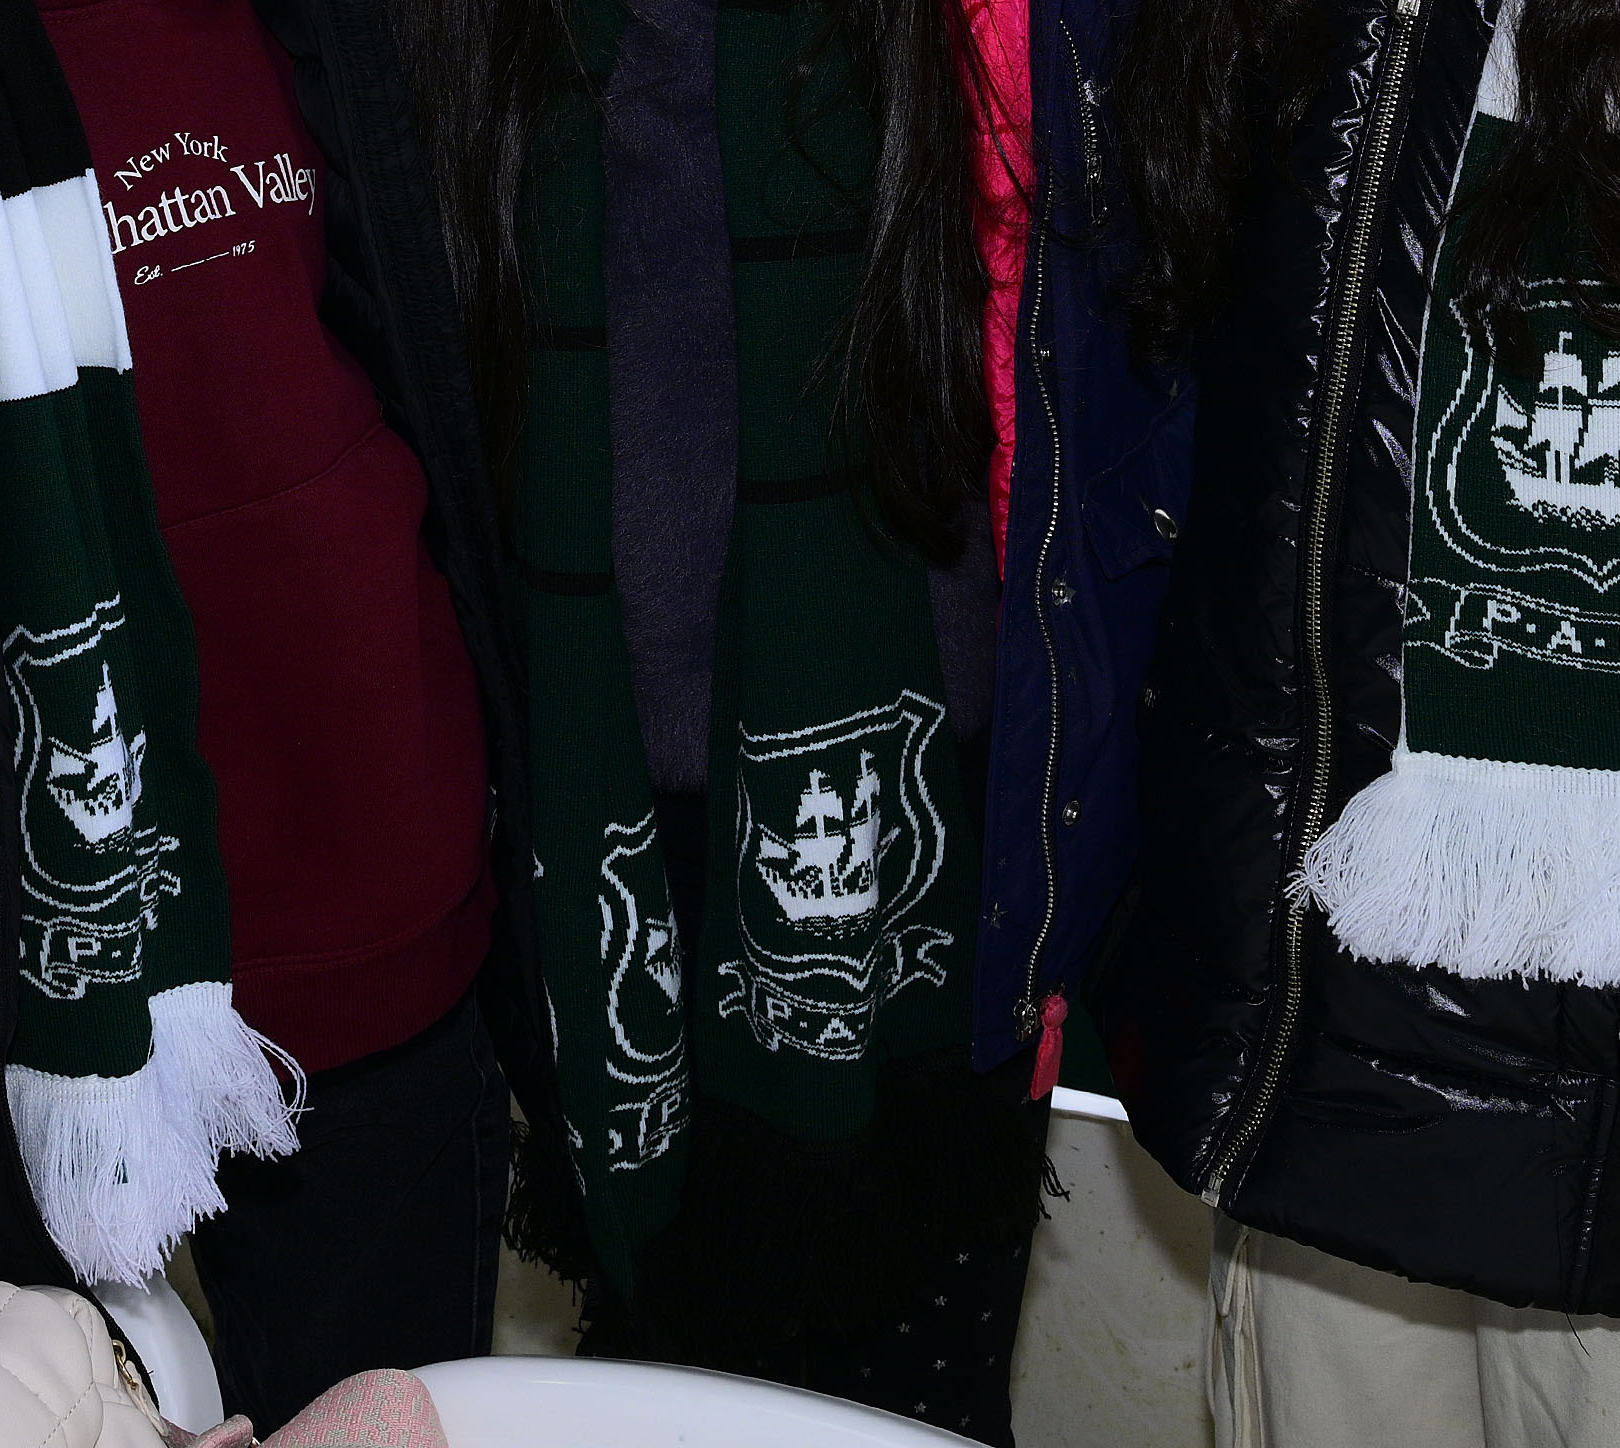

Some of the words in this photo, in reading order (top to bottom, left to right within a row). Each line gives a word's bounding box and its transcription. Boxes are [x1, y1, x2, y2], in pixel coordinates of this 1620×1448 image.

[114, 142, 172, 192] New
[174, 132, 229, 163] York
[230, 153, 317, 216] Valley
[231, 240, 257, 258] 1975
